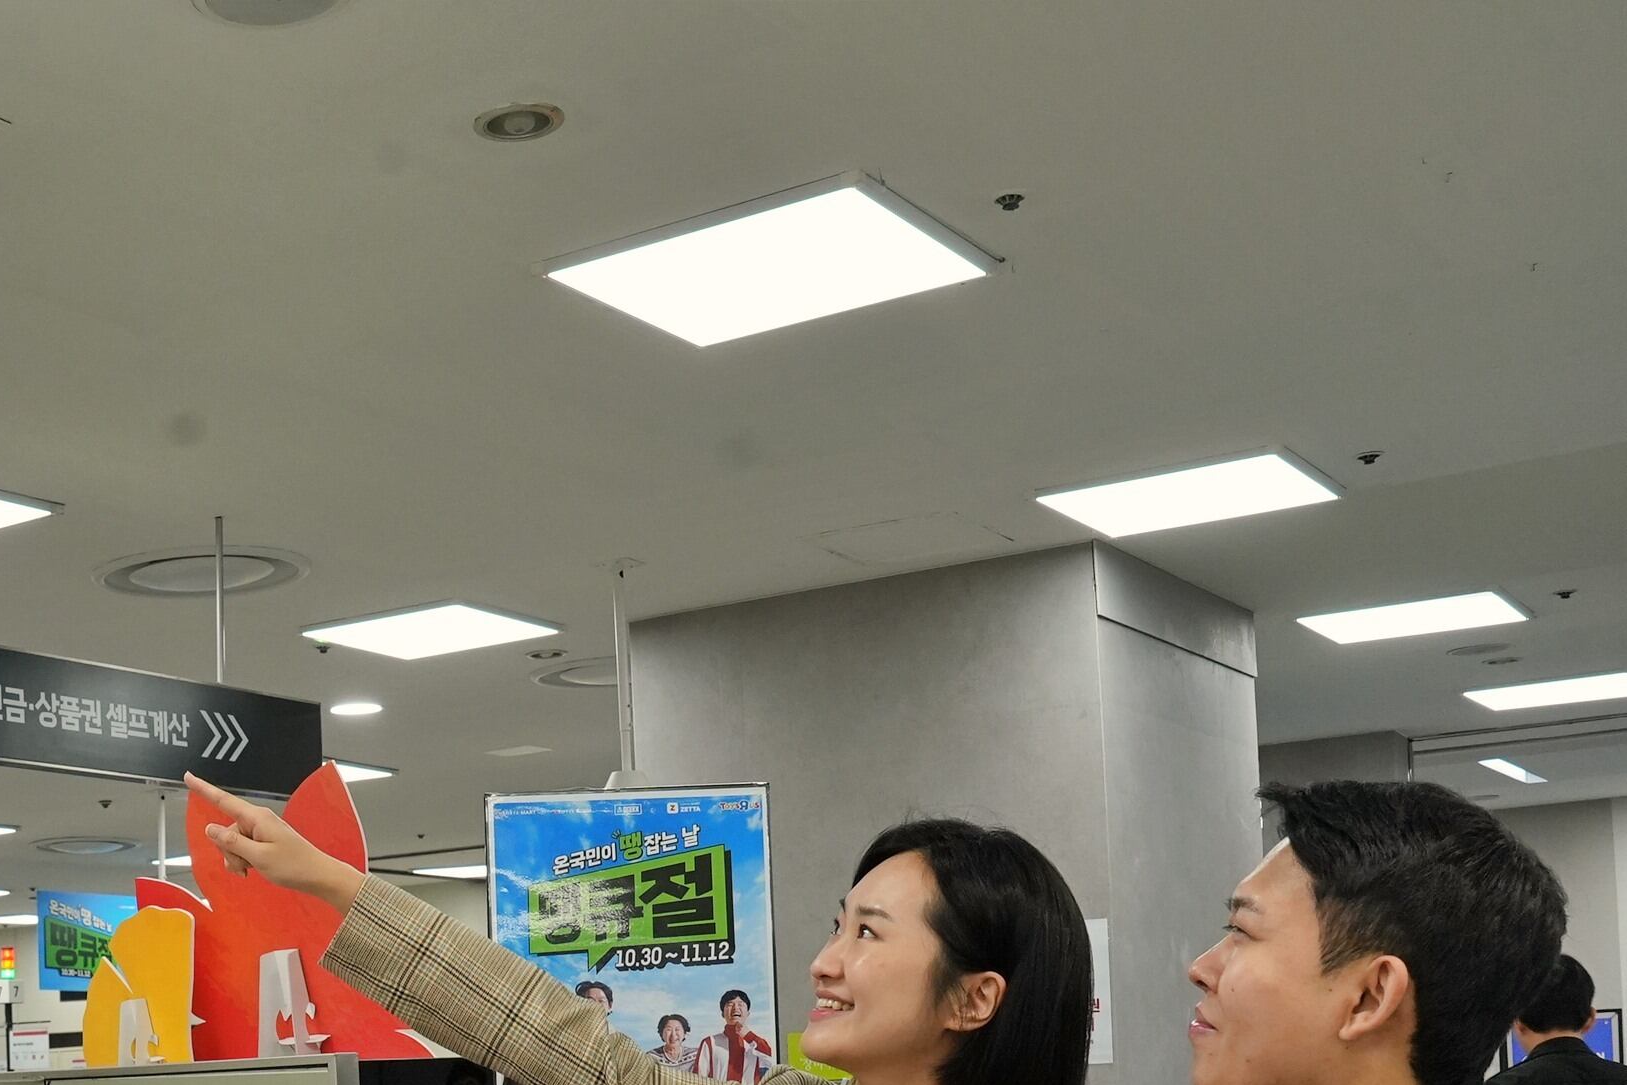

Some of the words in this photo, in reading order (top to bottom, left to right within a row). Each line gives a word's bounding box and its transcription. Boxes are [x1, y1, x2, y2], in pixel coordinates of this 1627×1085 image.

[106, 705, 190, 748] 셀프계산
[553, 842, 616, 876] 온국민이
[682, 824, 700, 847] 날
